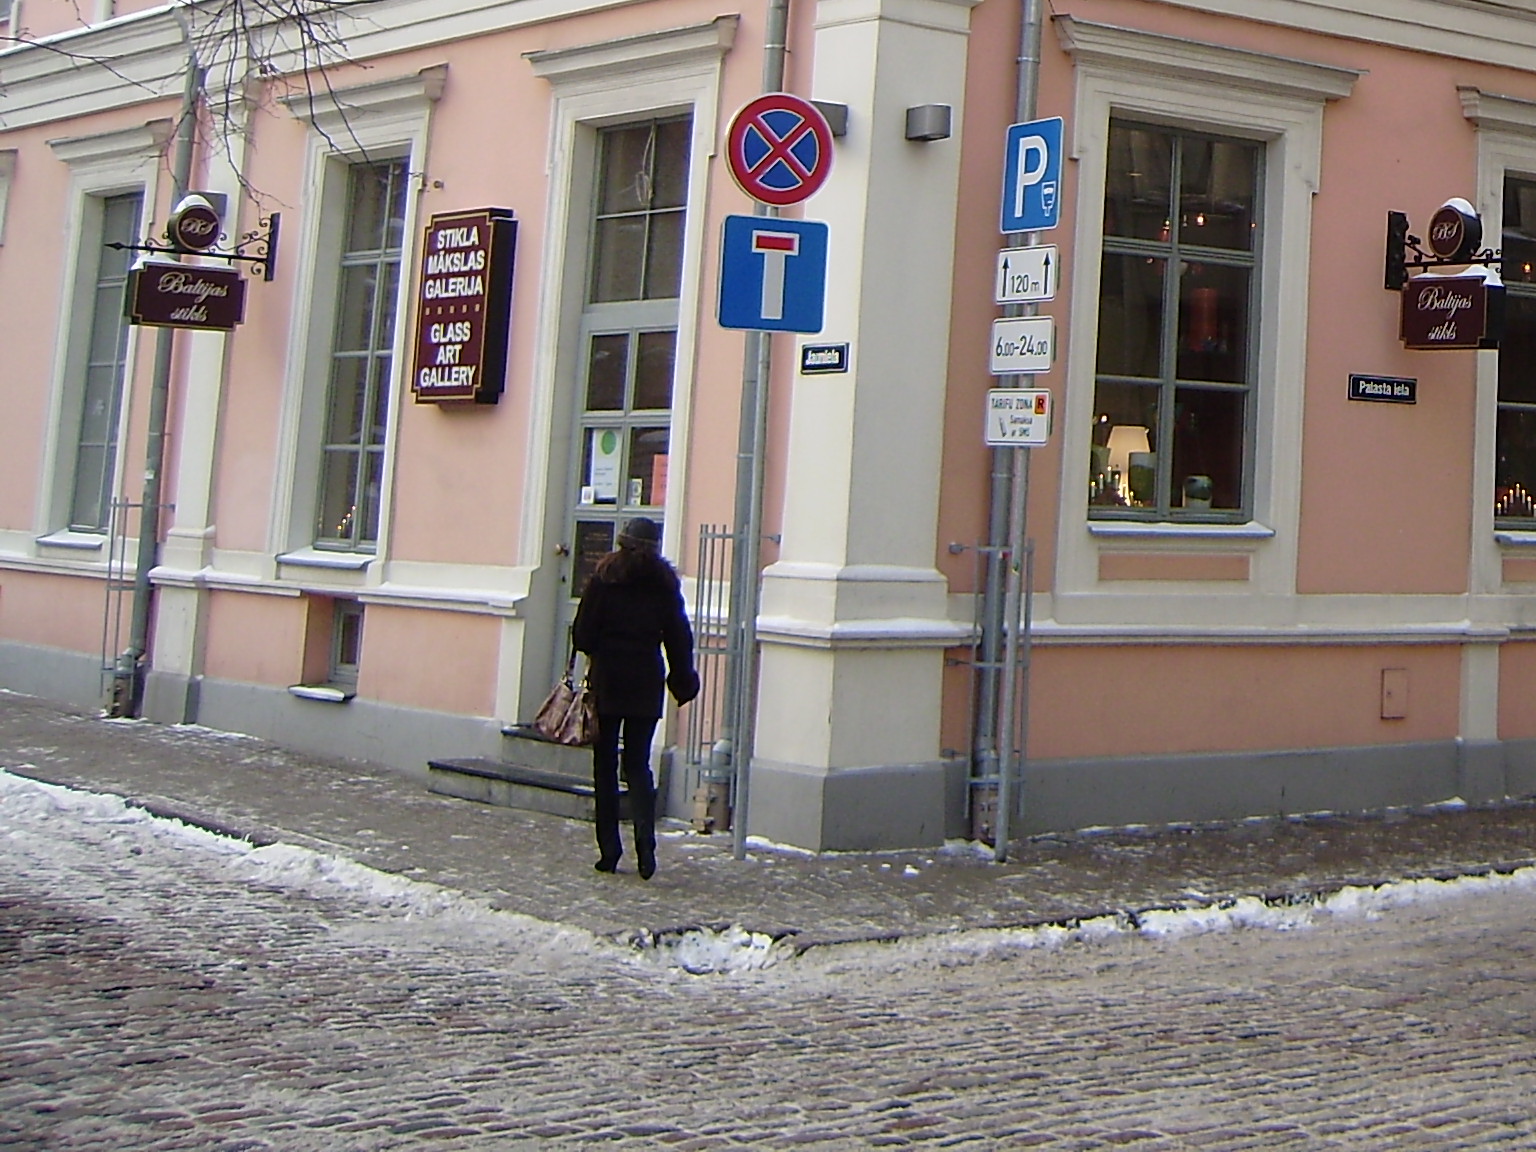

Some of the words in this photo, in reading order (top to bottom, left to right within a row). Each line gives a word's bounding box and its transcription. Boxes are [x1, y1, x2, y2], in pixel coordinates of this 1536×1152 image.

[1014, 135, 1048, 218] P
[437, 226, 479, 249] STIKLA
[427, 250, 485, 275] MĀKSLAS
[158, 272, 228, 303] Baltijas
[425, 275, 484, 298] GALERIJA
[1011, 274, 1029, 294] 120
[170, 305, 208, 322] stikls
[1417, 286, 1472, 319] Baltijas
[431, 321, 471, 343] GLASS
[1428, 321, 1457, 340] stikls
[436, 345, 462, 364] ART
[420, 365, 476, 387] GALLERY
[1359, 380, 1392, 395] Palasta
[1037, 398, 1045, 409] R
